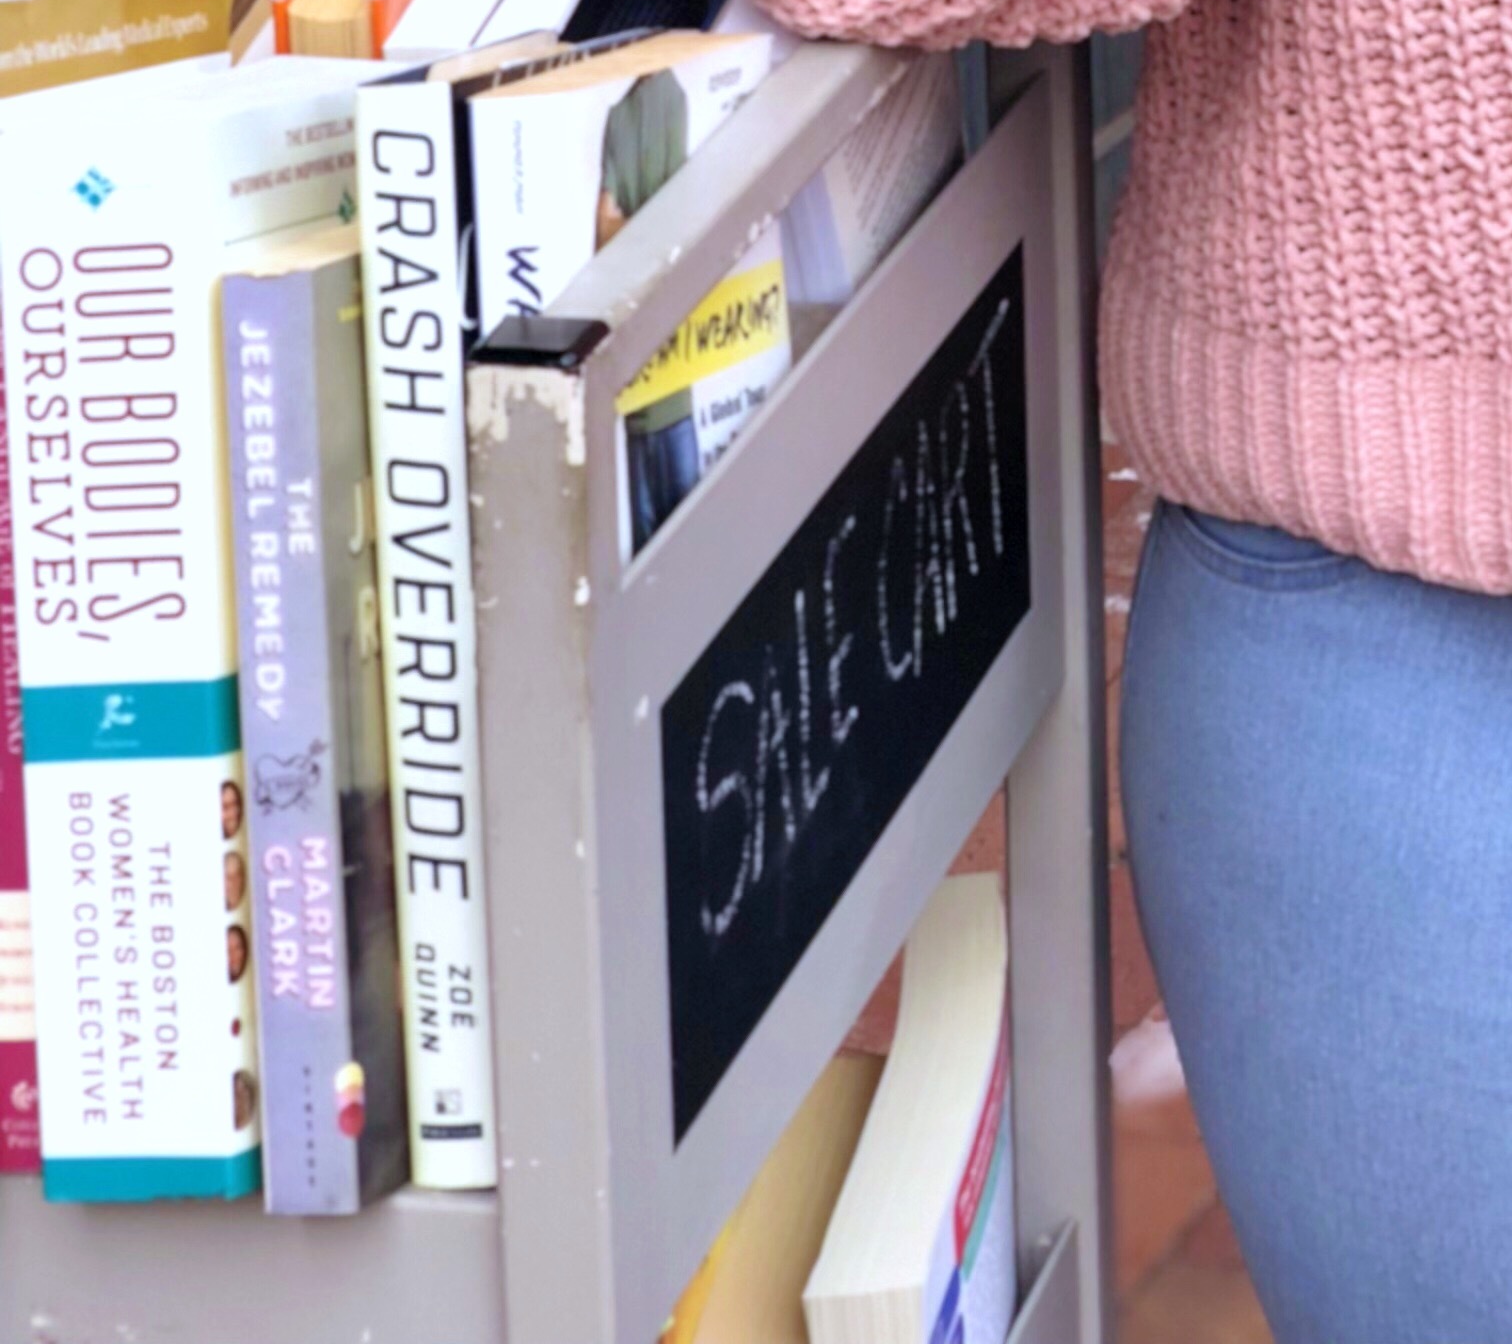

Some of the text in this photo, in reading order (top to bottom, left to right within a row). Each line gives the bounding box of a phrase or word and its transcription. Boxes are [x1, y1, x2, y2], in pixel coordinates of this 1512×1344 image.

[73, 243, 175, 363] OUR
[19, 247, 78, 626] OURSELVES
[239, 320, 287, 723] JEZEBEL REMEDY
[286, 476, 316, 557] THE
[372, 129, 469, 900] CRASH OVERRIDE
[696, 515, 858, 938] SALE
[876, 298, 1010, 680] CART
[68, 791, 108, 1125] BOOK COLLECTIVE
[107, 792, 145, 1121] WOMEN'S HEALTH
[148, 841, 179, 1072] THE BOSTON
[263, 845, 301, 998] CLARK
[301, 836, 336, 1008] MARTIN
[415, 942, 441, 1054] QUINN
[448, 964, 477, 1029] ZOE
